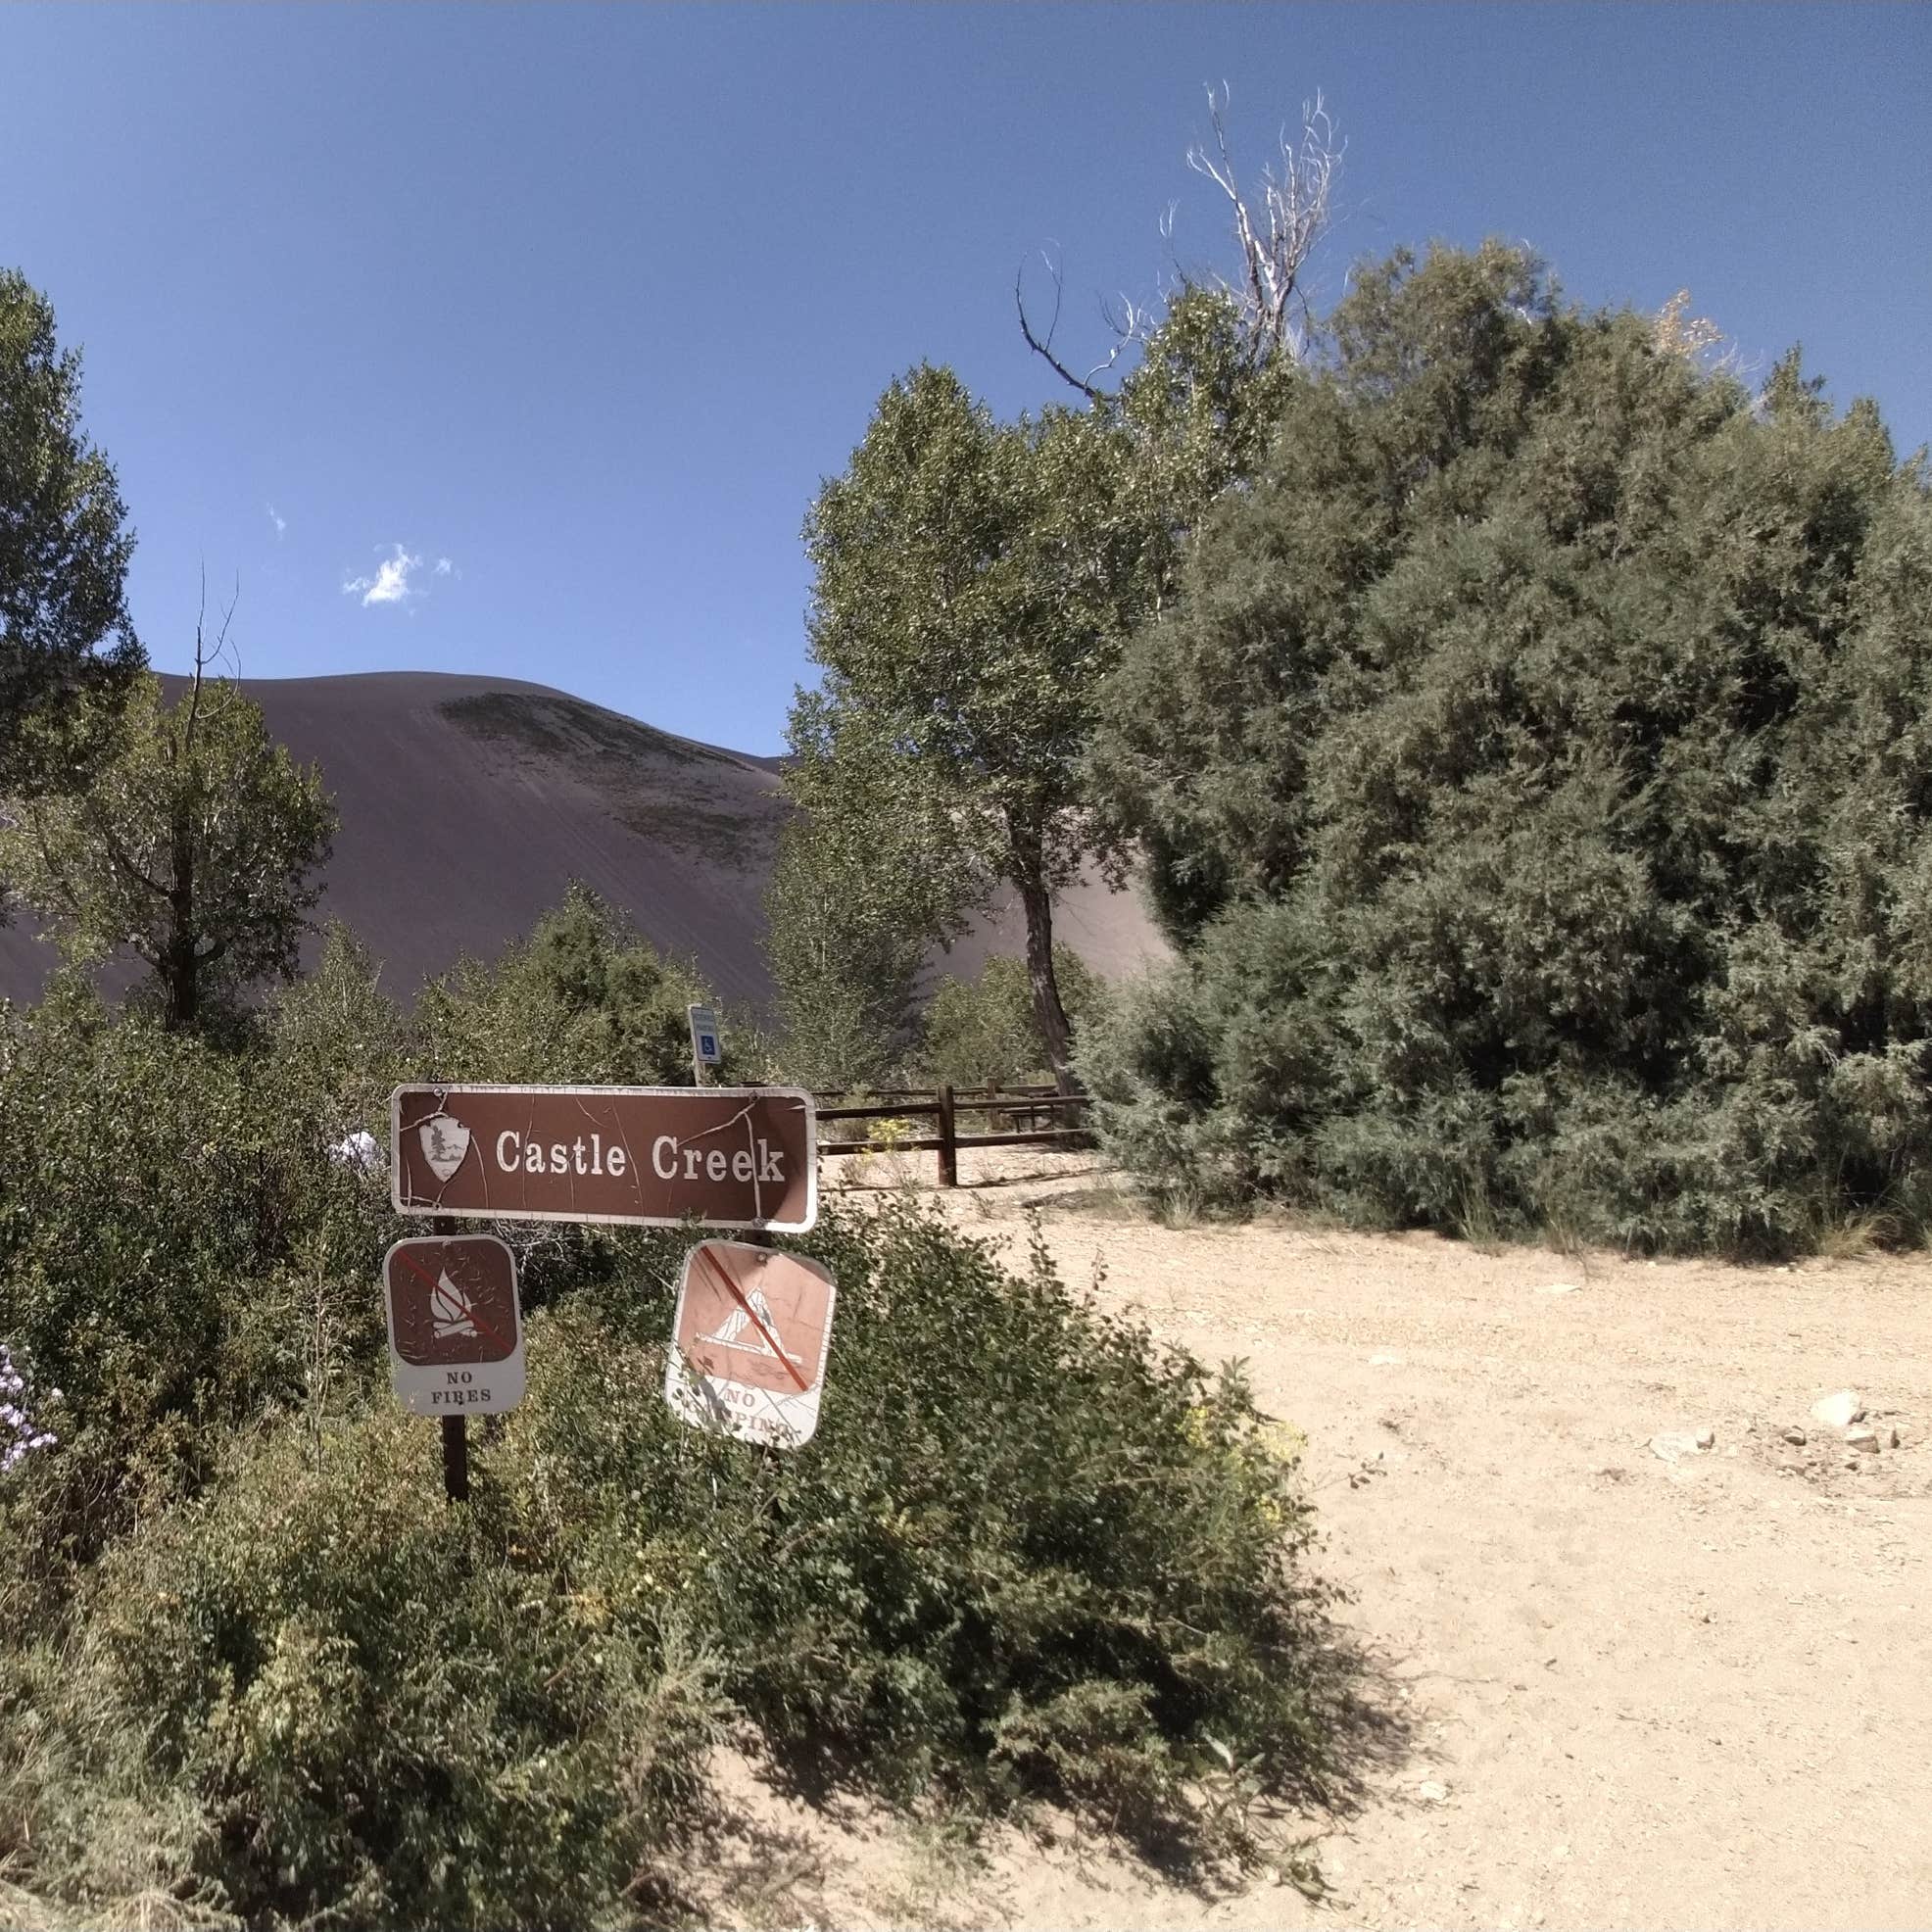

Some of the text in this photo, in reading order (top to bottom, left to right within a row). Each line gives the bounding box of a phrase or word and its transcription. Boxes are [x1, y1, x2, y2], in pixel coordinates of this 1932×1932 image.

[496, 1130, 786, 1183] Castle Creek
[447, 1372, 473, 1384] NO
[431, 1388, 492, 1405] FIRES
[723, 1387, 756, 1408] NO
